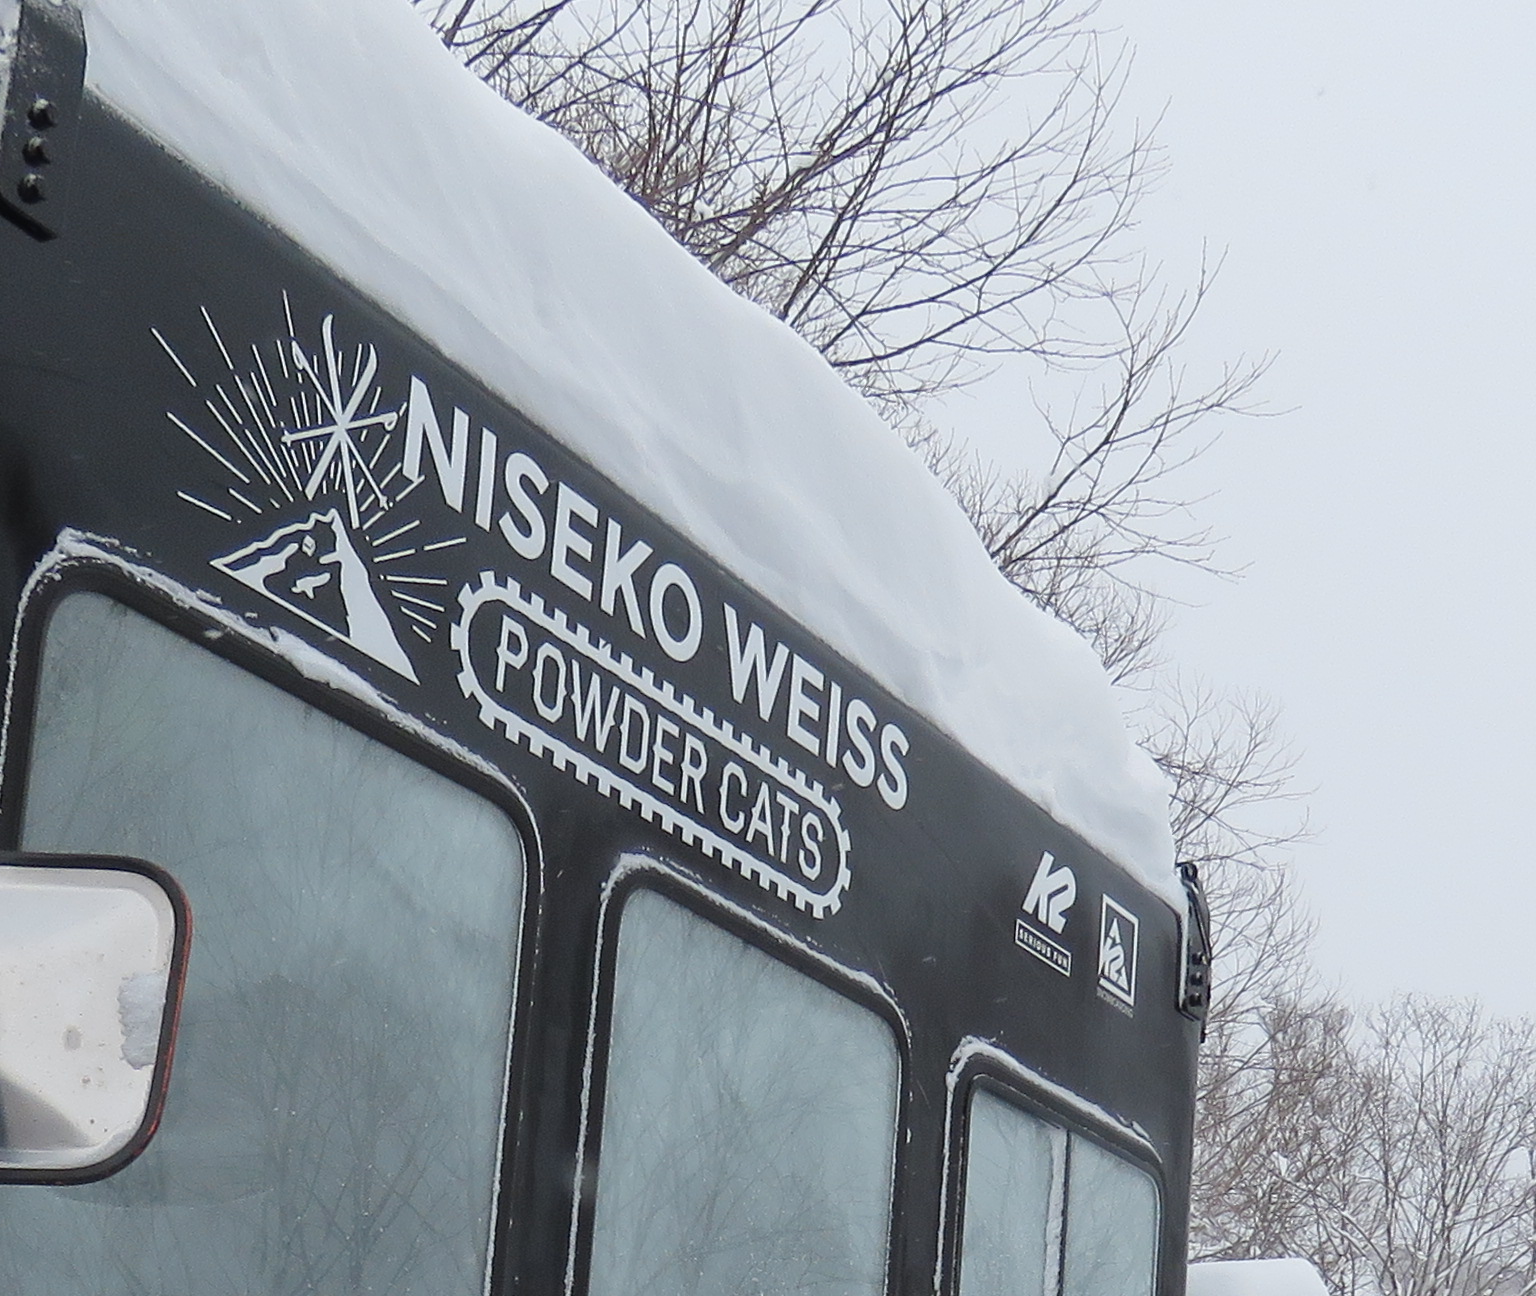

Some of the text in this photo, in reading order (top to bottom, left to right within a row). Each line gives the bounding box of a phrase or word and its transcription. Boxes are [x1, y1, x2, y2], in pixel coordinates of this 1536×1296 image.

[402, 374, 910, 811] NISEKO WEISS
[496, 614, 825, 882] POWDER CATS
[1021, 850, 1077, 935] K2
